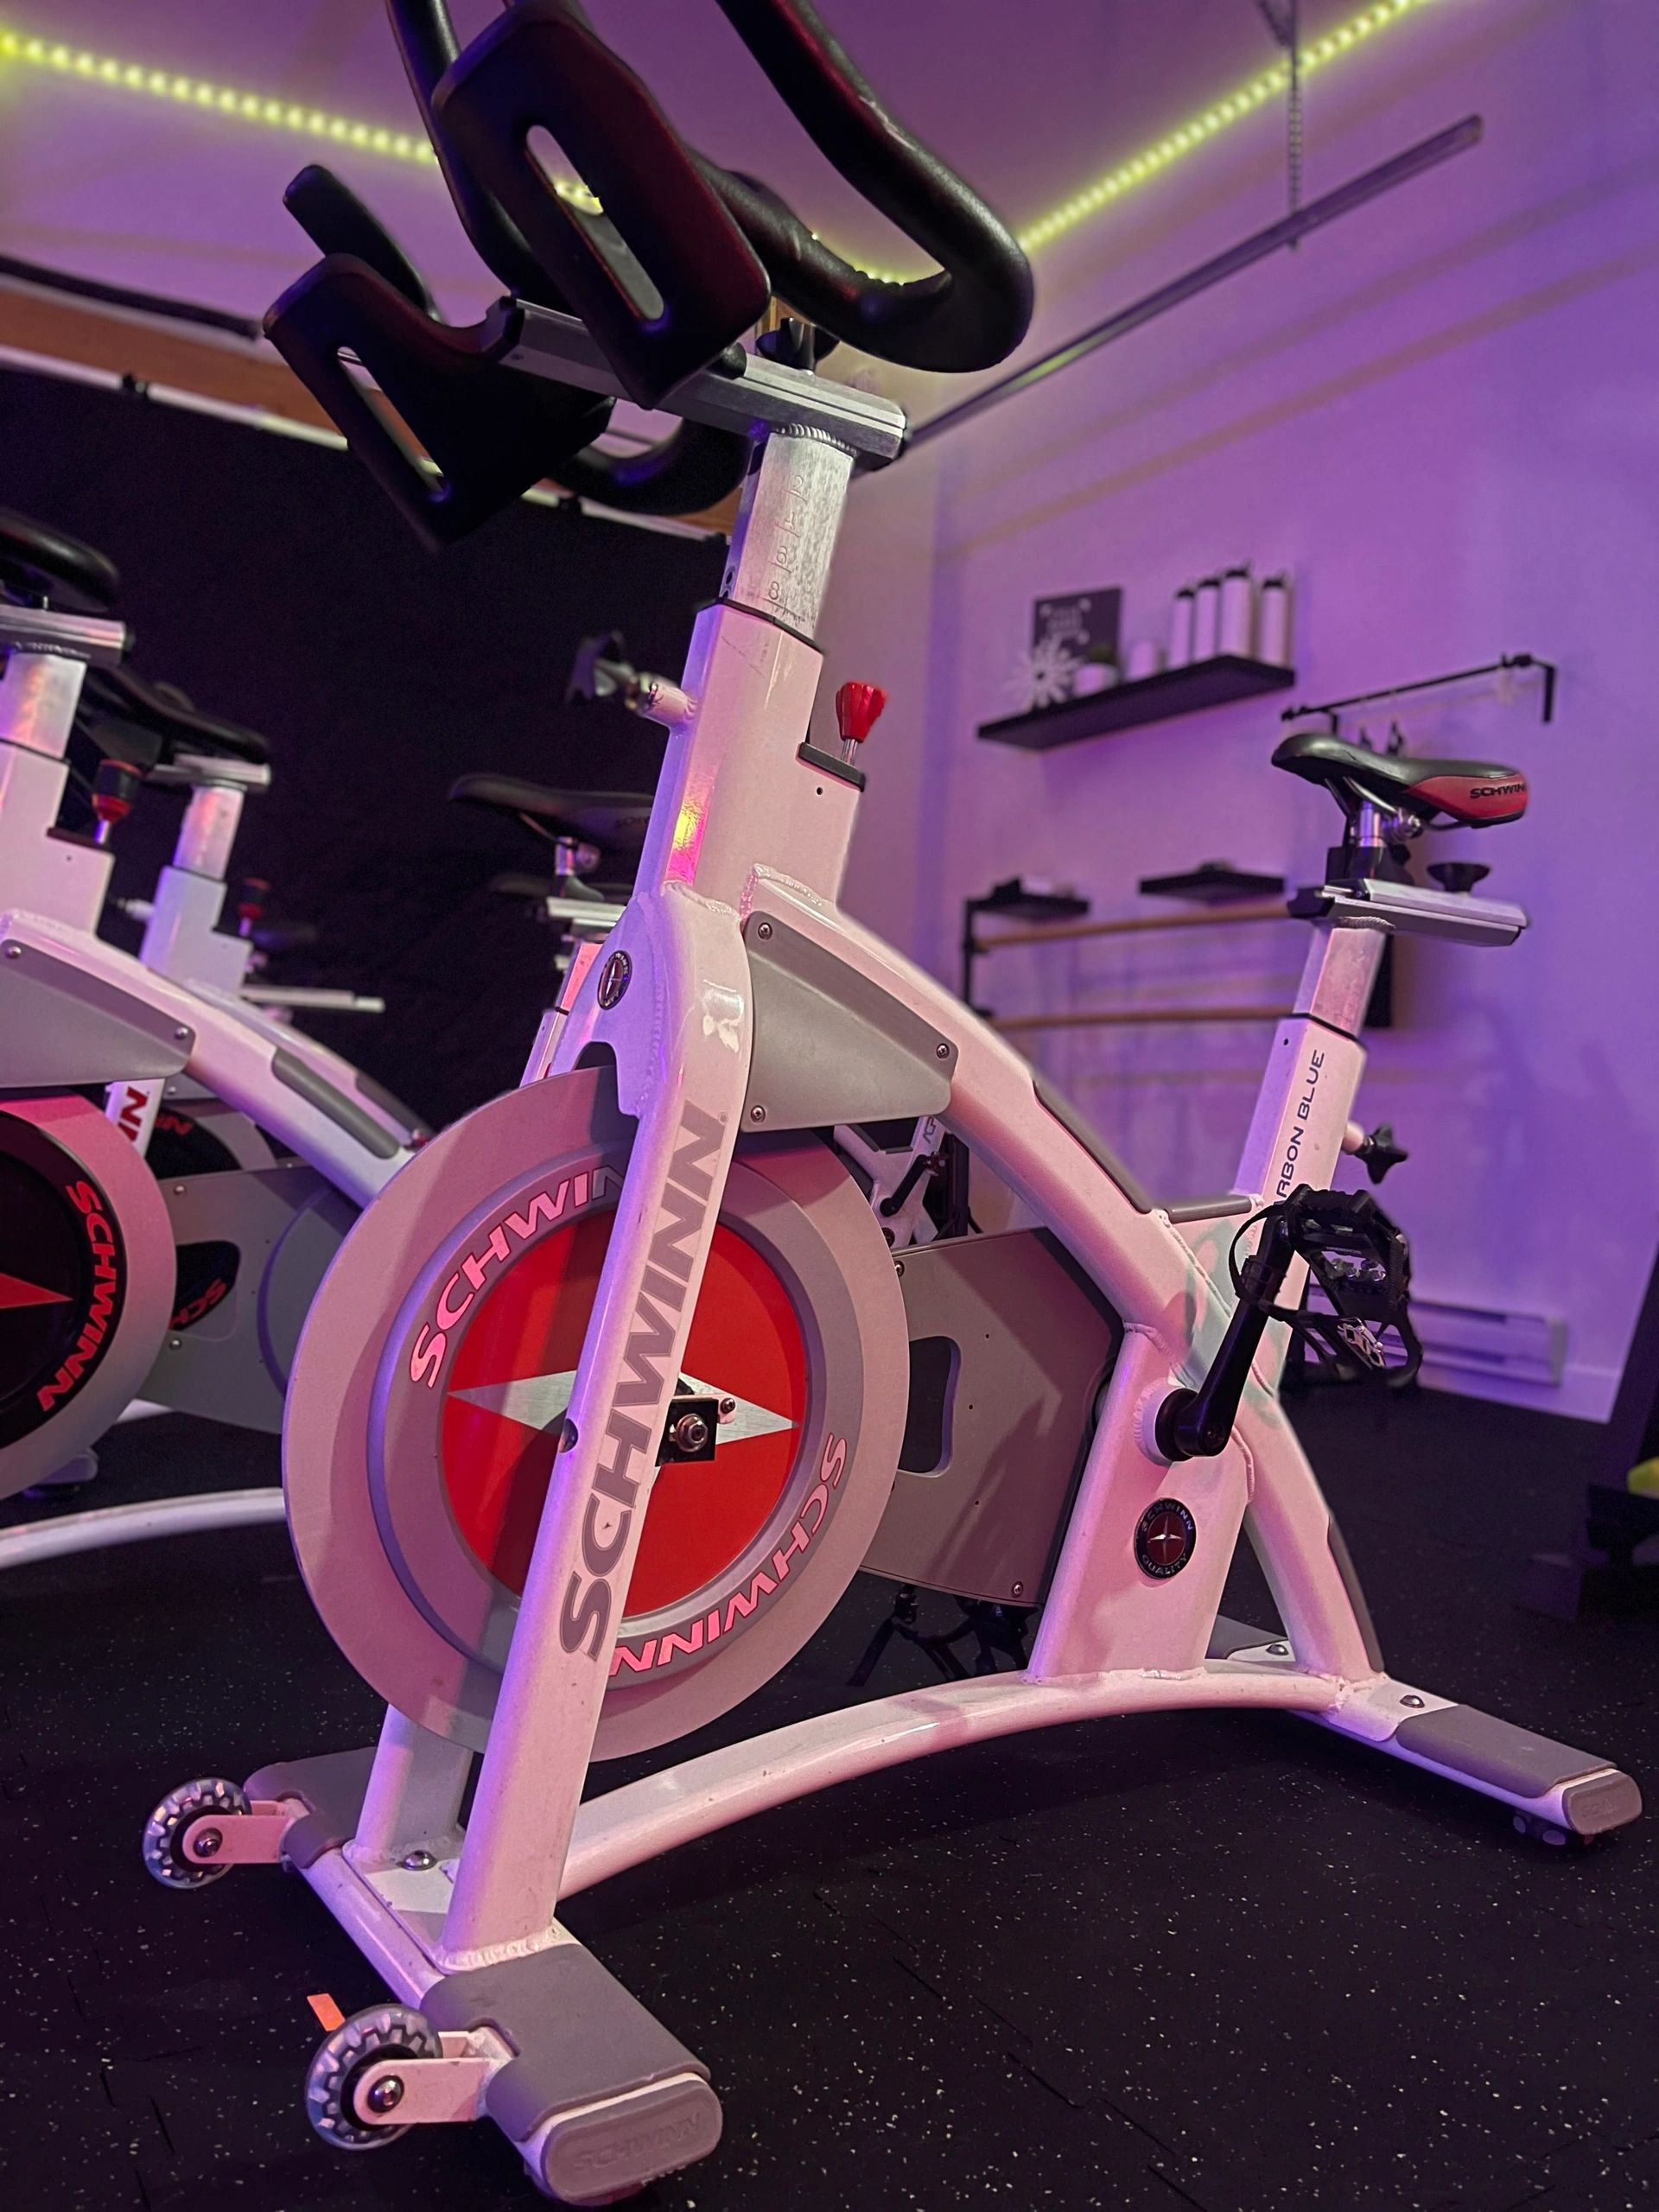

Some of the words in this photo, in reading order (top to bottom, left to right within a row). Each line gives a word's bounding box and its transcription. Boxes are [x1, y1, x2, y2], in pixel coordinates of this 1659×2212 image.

[769, 581, 780, 601] 8
[1470, 784, 1525, 798] SCHWIN
[1276, 1126, 1304, 1198] RBON
[1297, 1049, 1325, 1121] BLUE
[36, 1180, 117, 1411] SCHWINN
[409, 1164, 625, 1389] SCHWIN
[560, 1100, 725, 1661] SCHWINN
[607, 1432, 849, 1677] SCHWINN
[1141, 1503, 1193, 1532] SCHWINN
[1141, 1553, 1187, 1575] QUALITY
